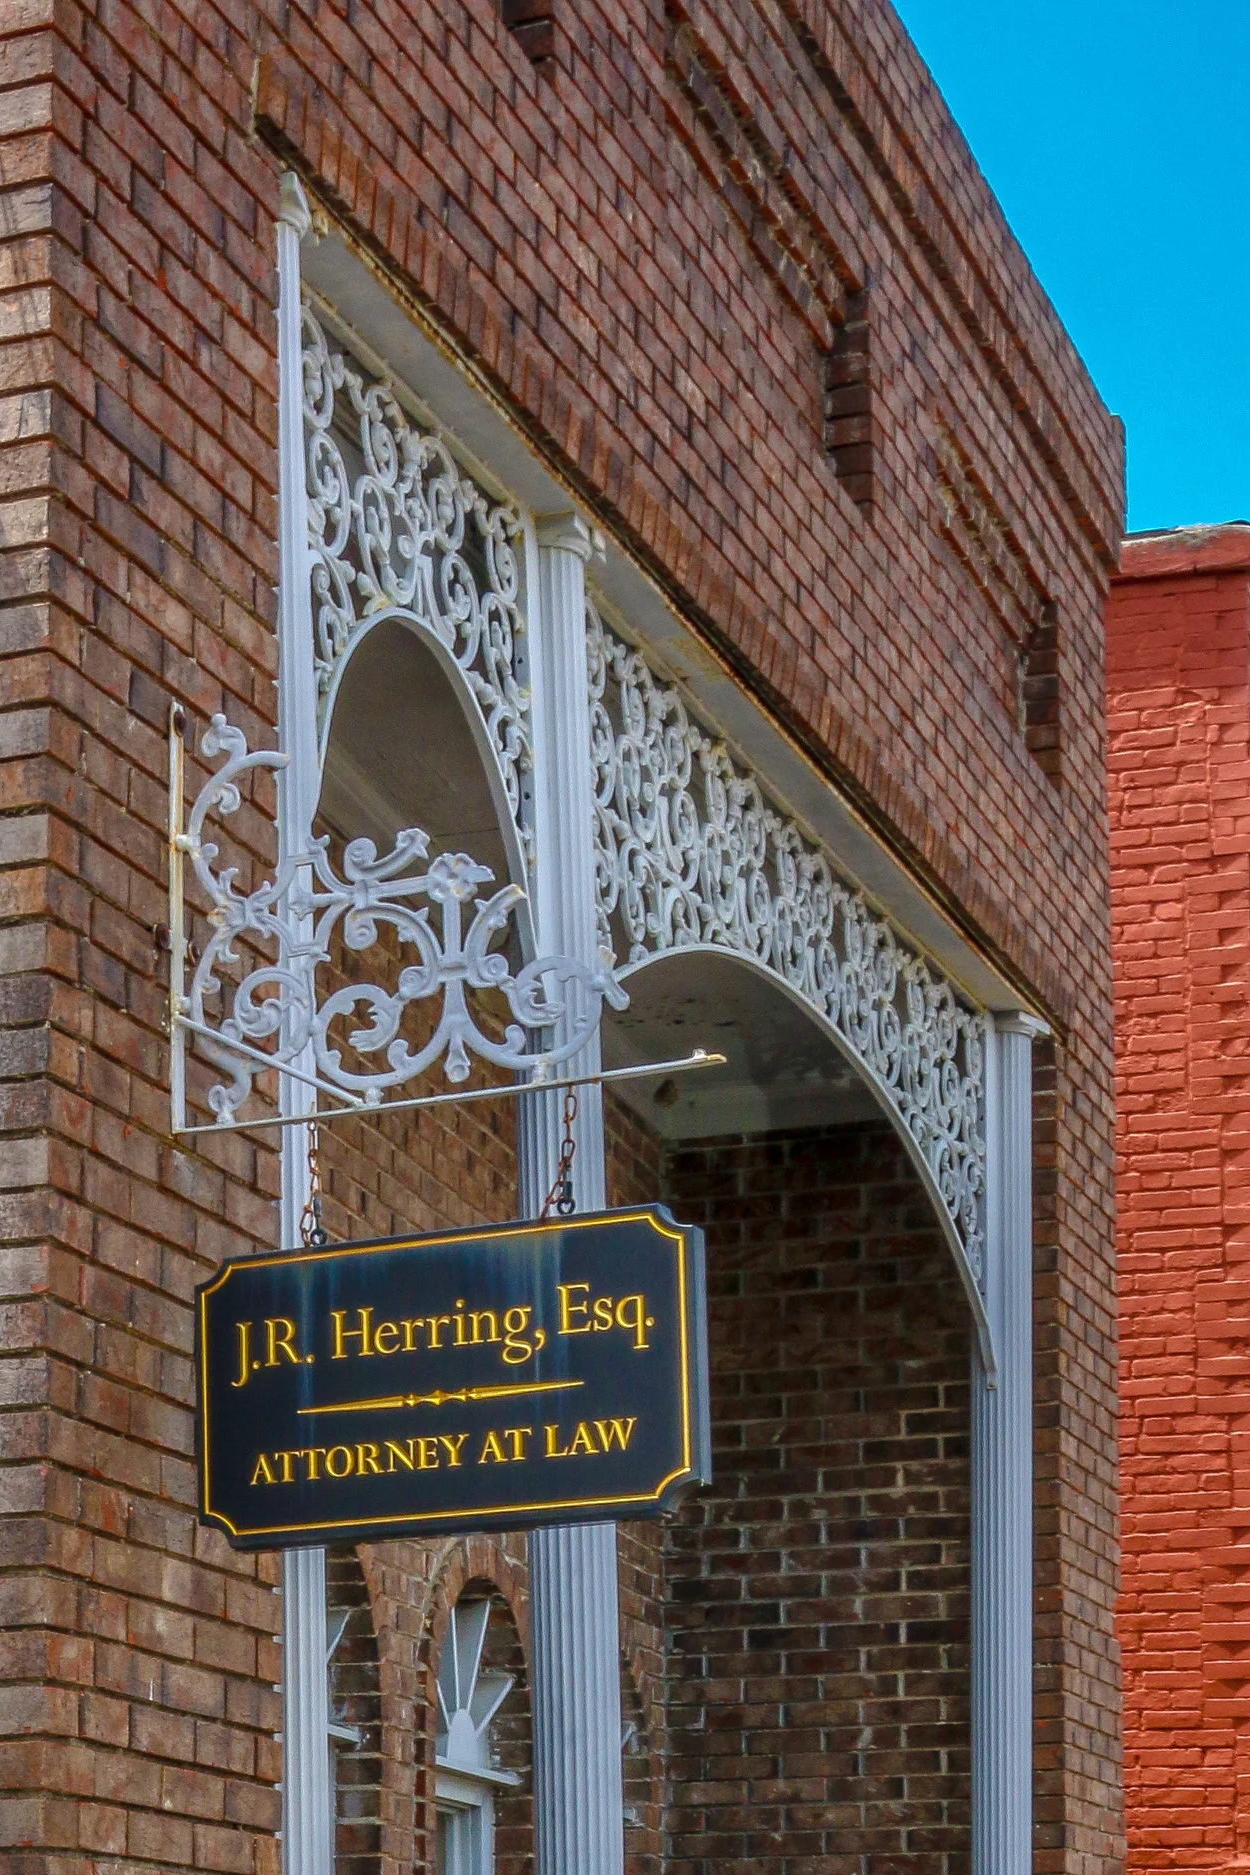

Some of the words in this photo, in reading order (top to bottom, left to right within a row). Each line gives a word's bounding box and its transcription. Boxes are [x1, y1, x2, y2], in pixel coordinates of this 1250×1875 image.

[231, 1317, 315, 1388] J.R.
[330, 1298, 547, 1366] Herring,
[555, 1281, 655, 1350] Esq.
[250, 1433, 469, 1486] ATTORNEY
[477, 1427, 533, 1465] AT
[544, 1416, 637, 1459] LAW
